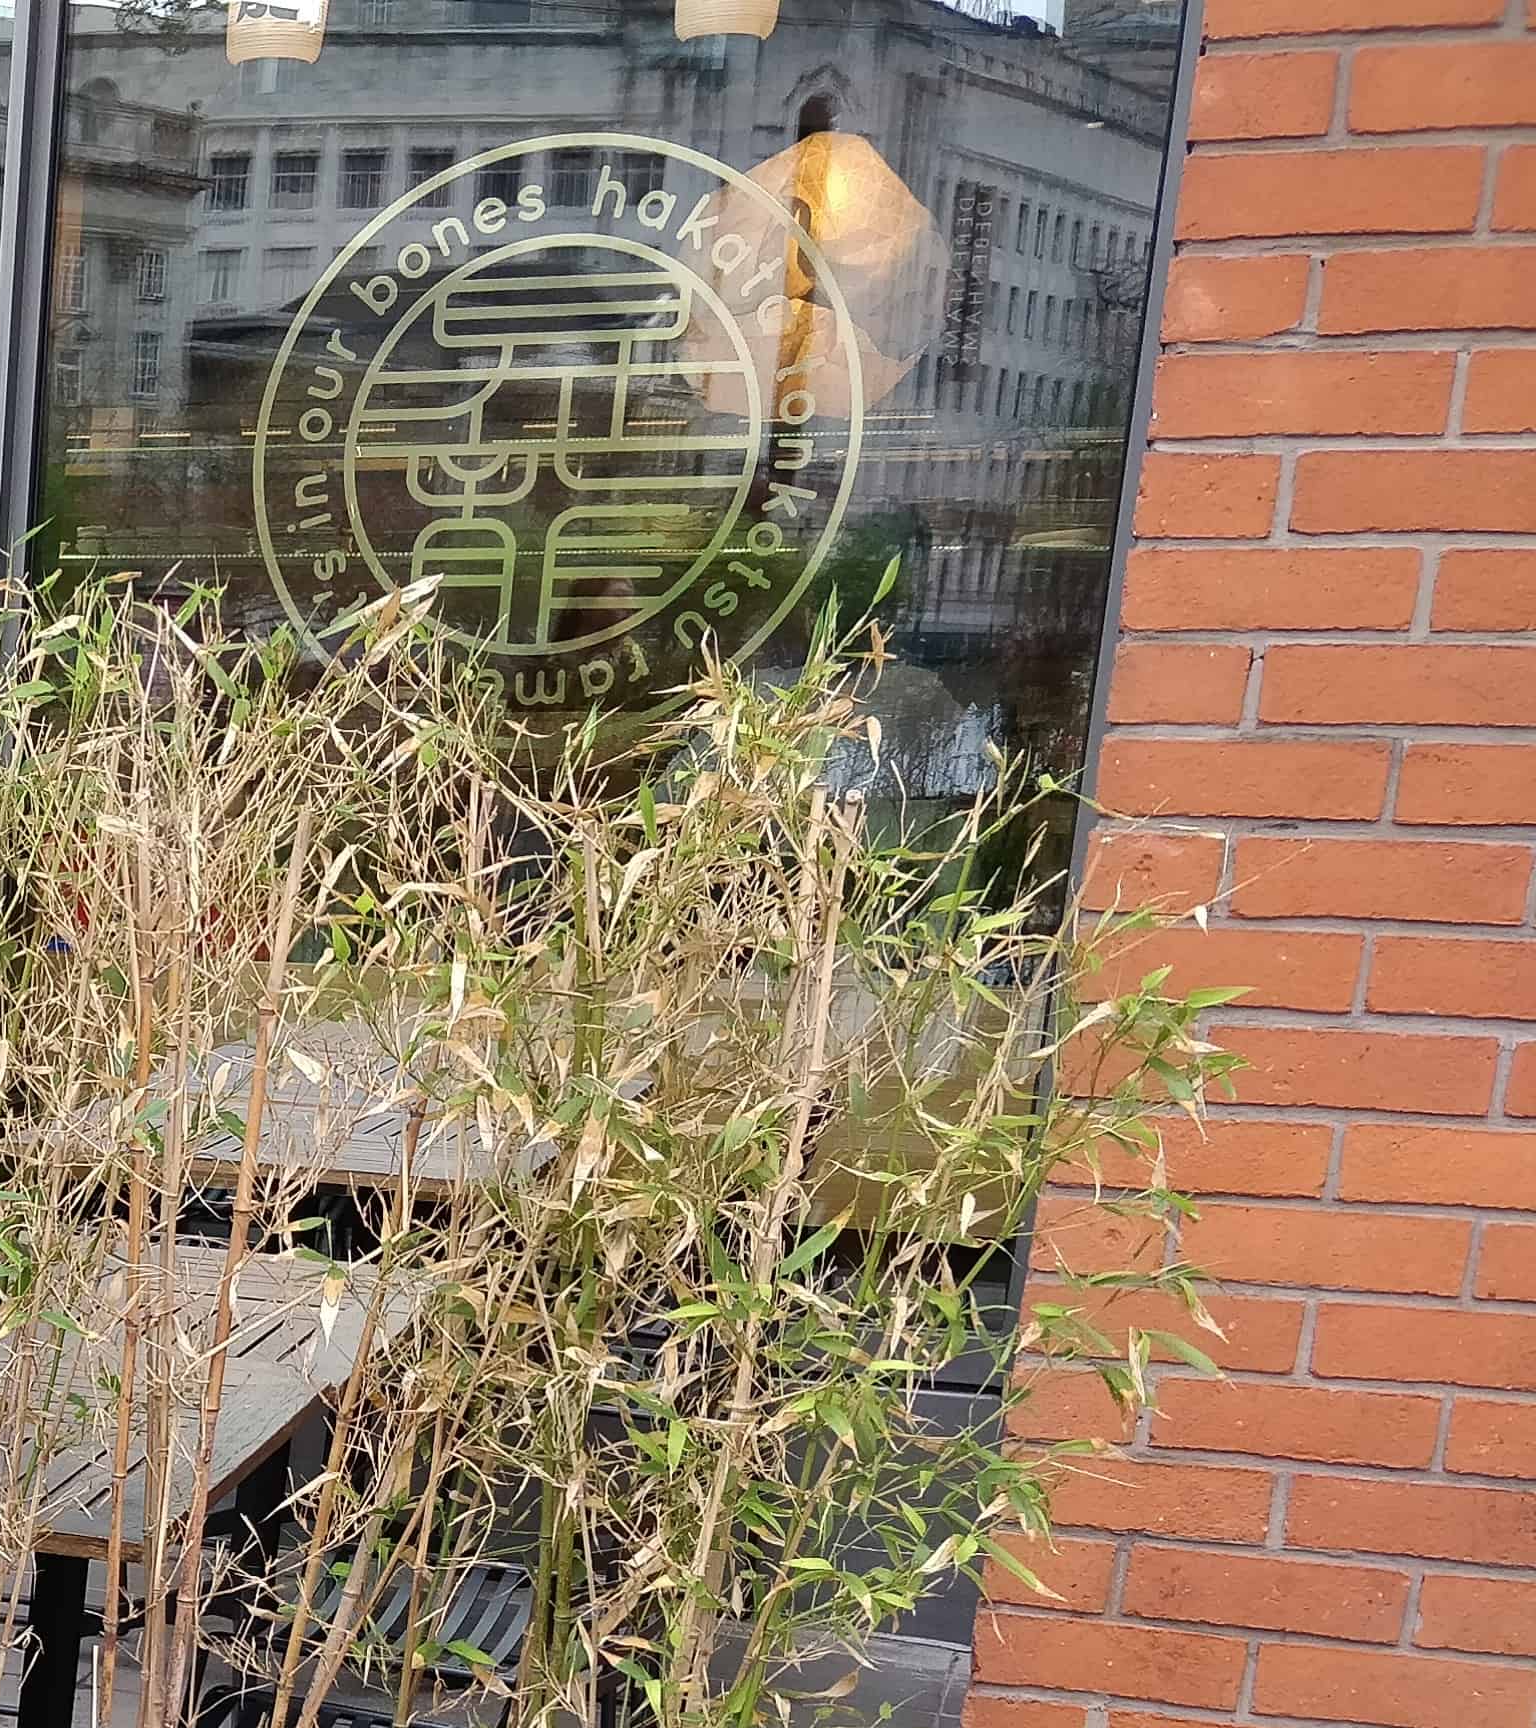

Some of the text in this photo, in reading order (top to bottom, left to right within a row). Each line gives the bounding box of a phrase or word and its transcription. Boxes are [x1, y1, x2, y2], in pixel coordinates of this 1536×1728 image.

[349, 183, 547, 316] bones
[298, 329, 357, 442] our
[286, 471, 332, 534] in
